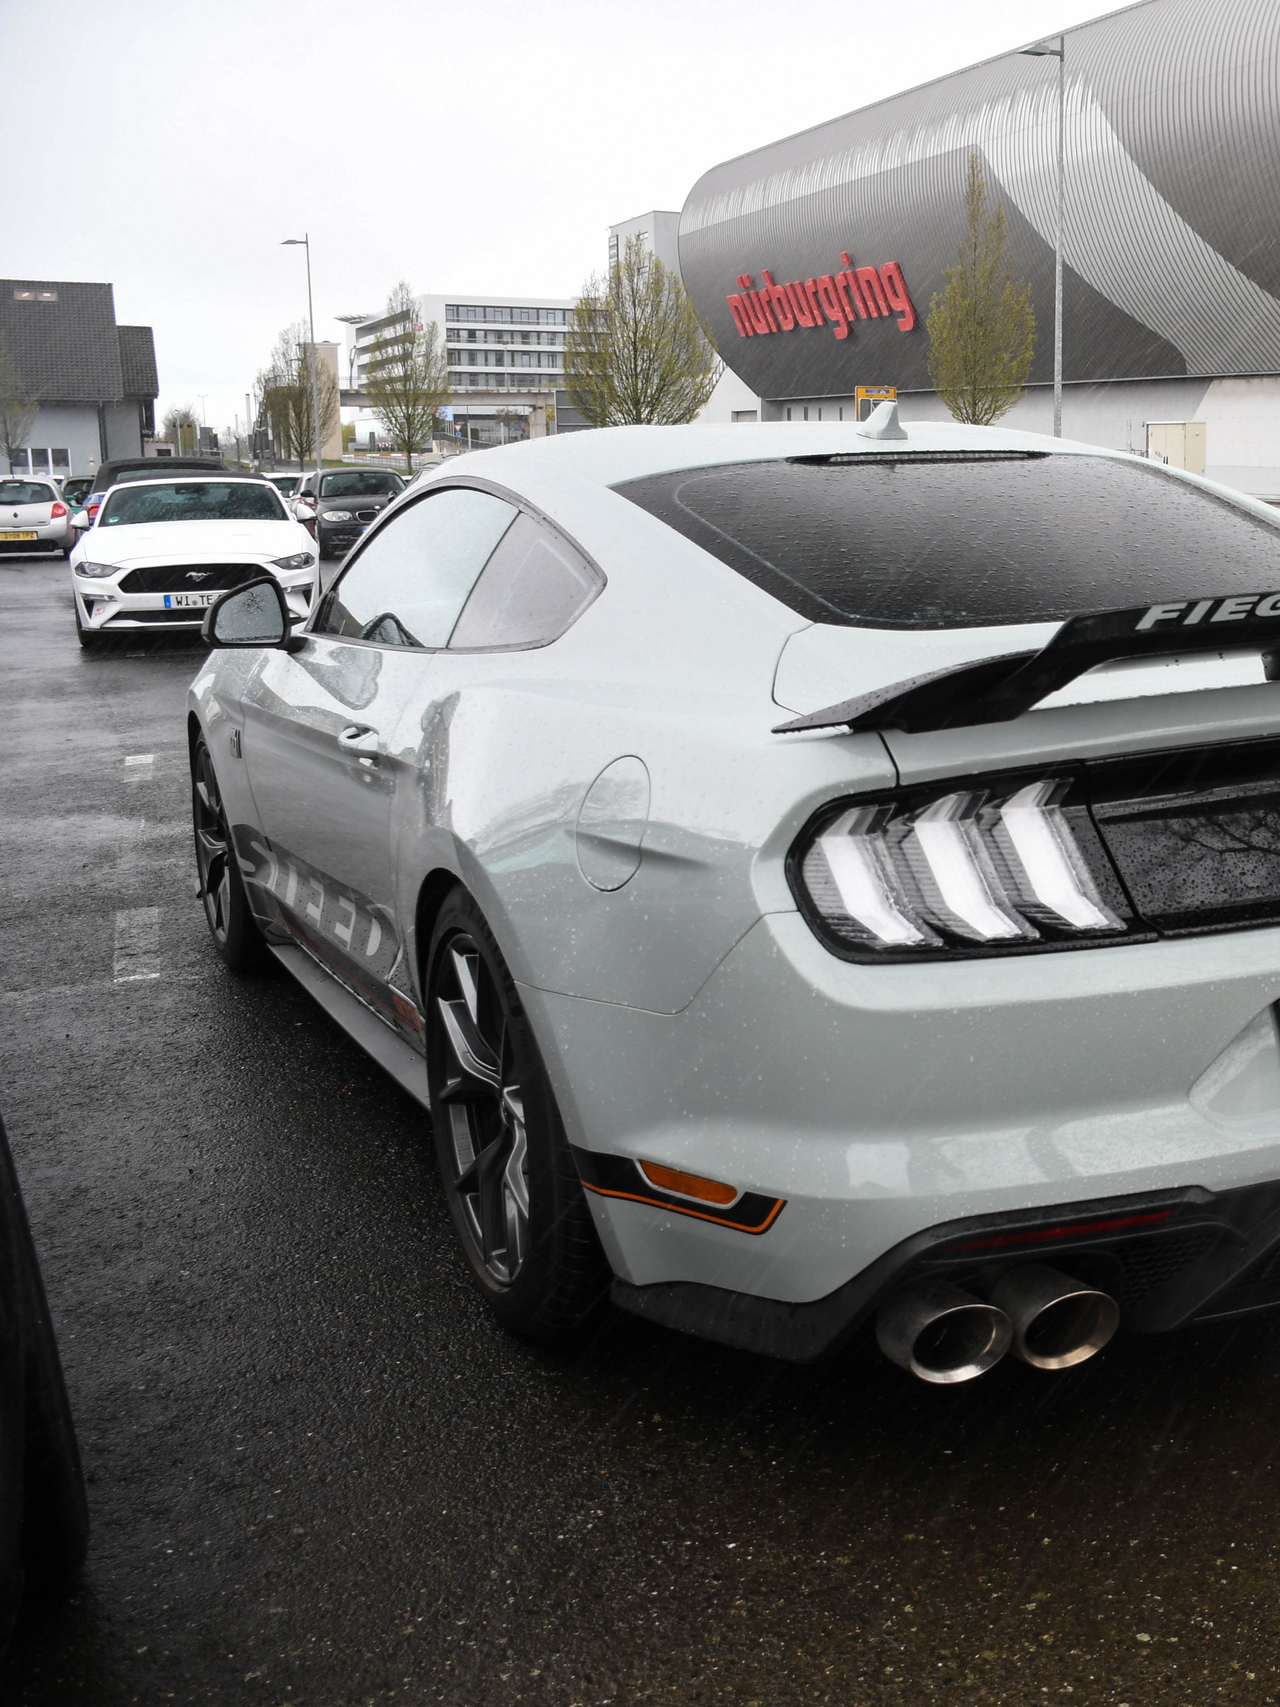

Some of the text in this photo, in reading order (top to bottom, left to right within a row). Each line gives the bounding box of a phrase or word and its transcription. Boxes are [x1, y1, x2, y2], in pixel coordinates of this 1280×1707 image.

[726, 251, 916, 339] nürburgring
[175, 595, 191, 606] WI
[199, 594, 213, 606] TE
